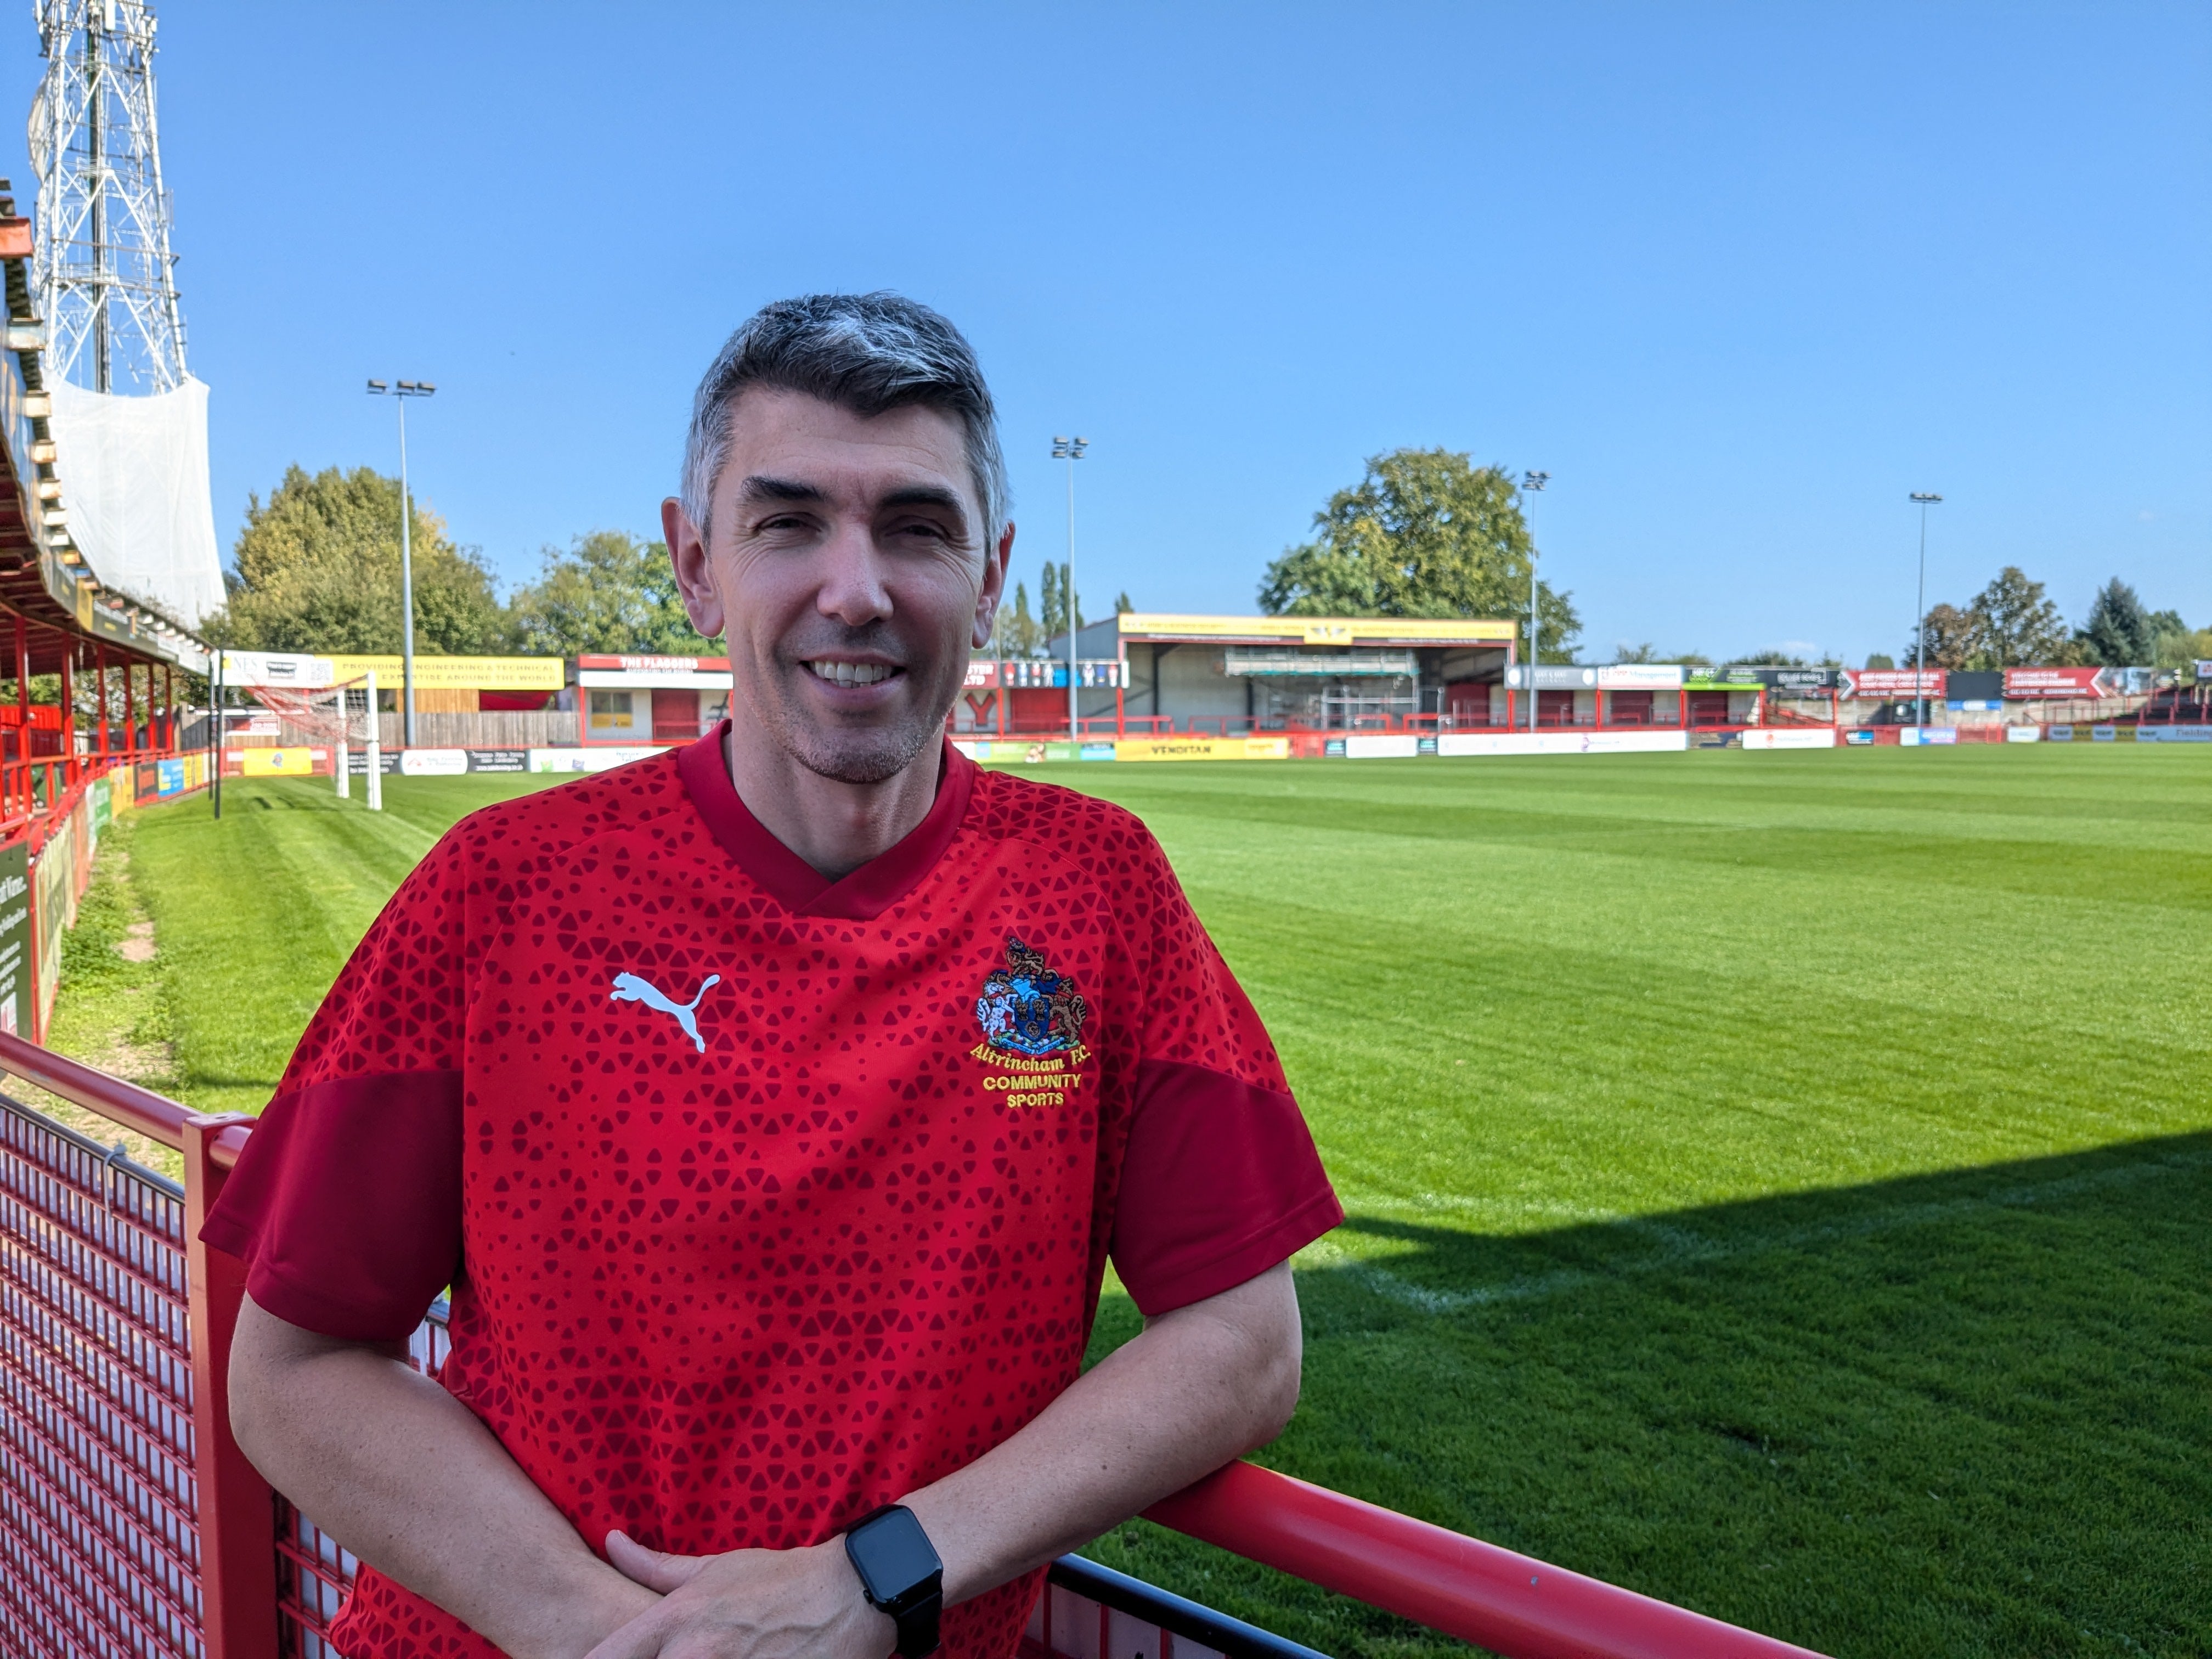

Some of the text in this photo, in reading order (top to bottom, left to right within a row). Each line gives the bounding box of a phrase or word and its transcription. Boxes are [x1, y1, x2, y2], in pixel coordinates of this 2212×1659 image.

[970, 1043, 1065, 1071] Altrincham
[983, 1074, 1082, 1091] COMMUNITY
[1007, 1092, 1064, 1108] SPORTS
